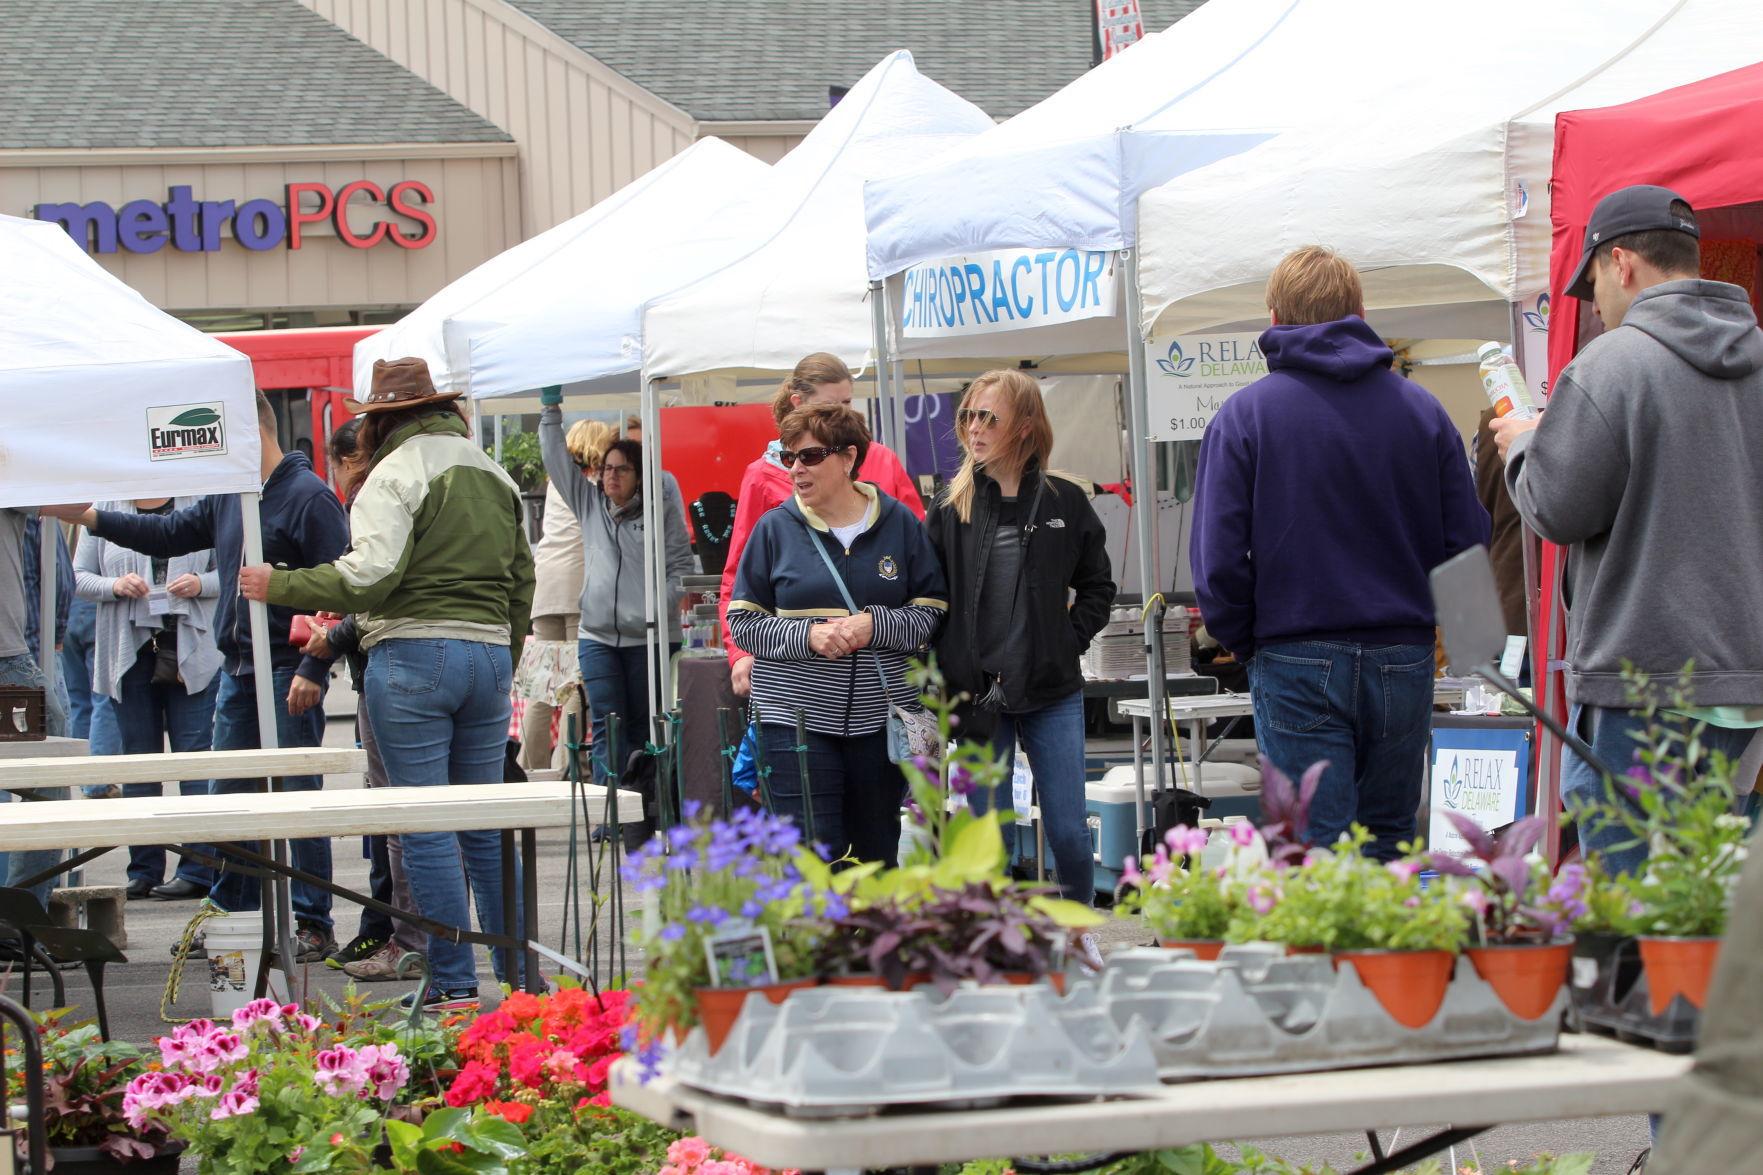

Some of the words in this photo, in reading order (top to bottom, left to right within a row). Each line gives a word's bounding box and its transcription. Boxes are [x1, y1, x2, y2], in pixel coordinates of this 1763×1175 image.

[34, 180, 437, 254] metroPCS
[903, 247, 1106, 329] CHIROPRACTOR
[1198, 339, 1265, 363] RELA
[1201, 360, 1267, 377] DELAWA
[1203, 381, 1228, 389] Approach
[1170, 417, 1206, 431] $1.00
[151, 426, 219, 450] Eurmax
[1463, 758, 1504, 790] RELAX
[1461, 790, 1502, 812] DELAWARE
